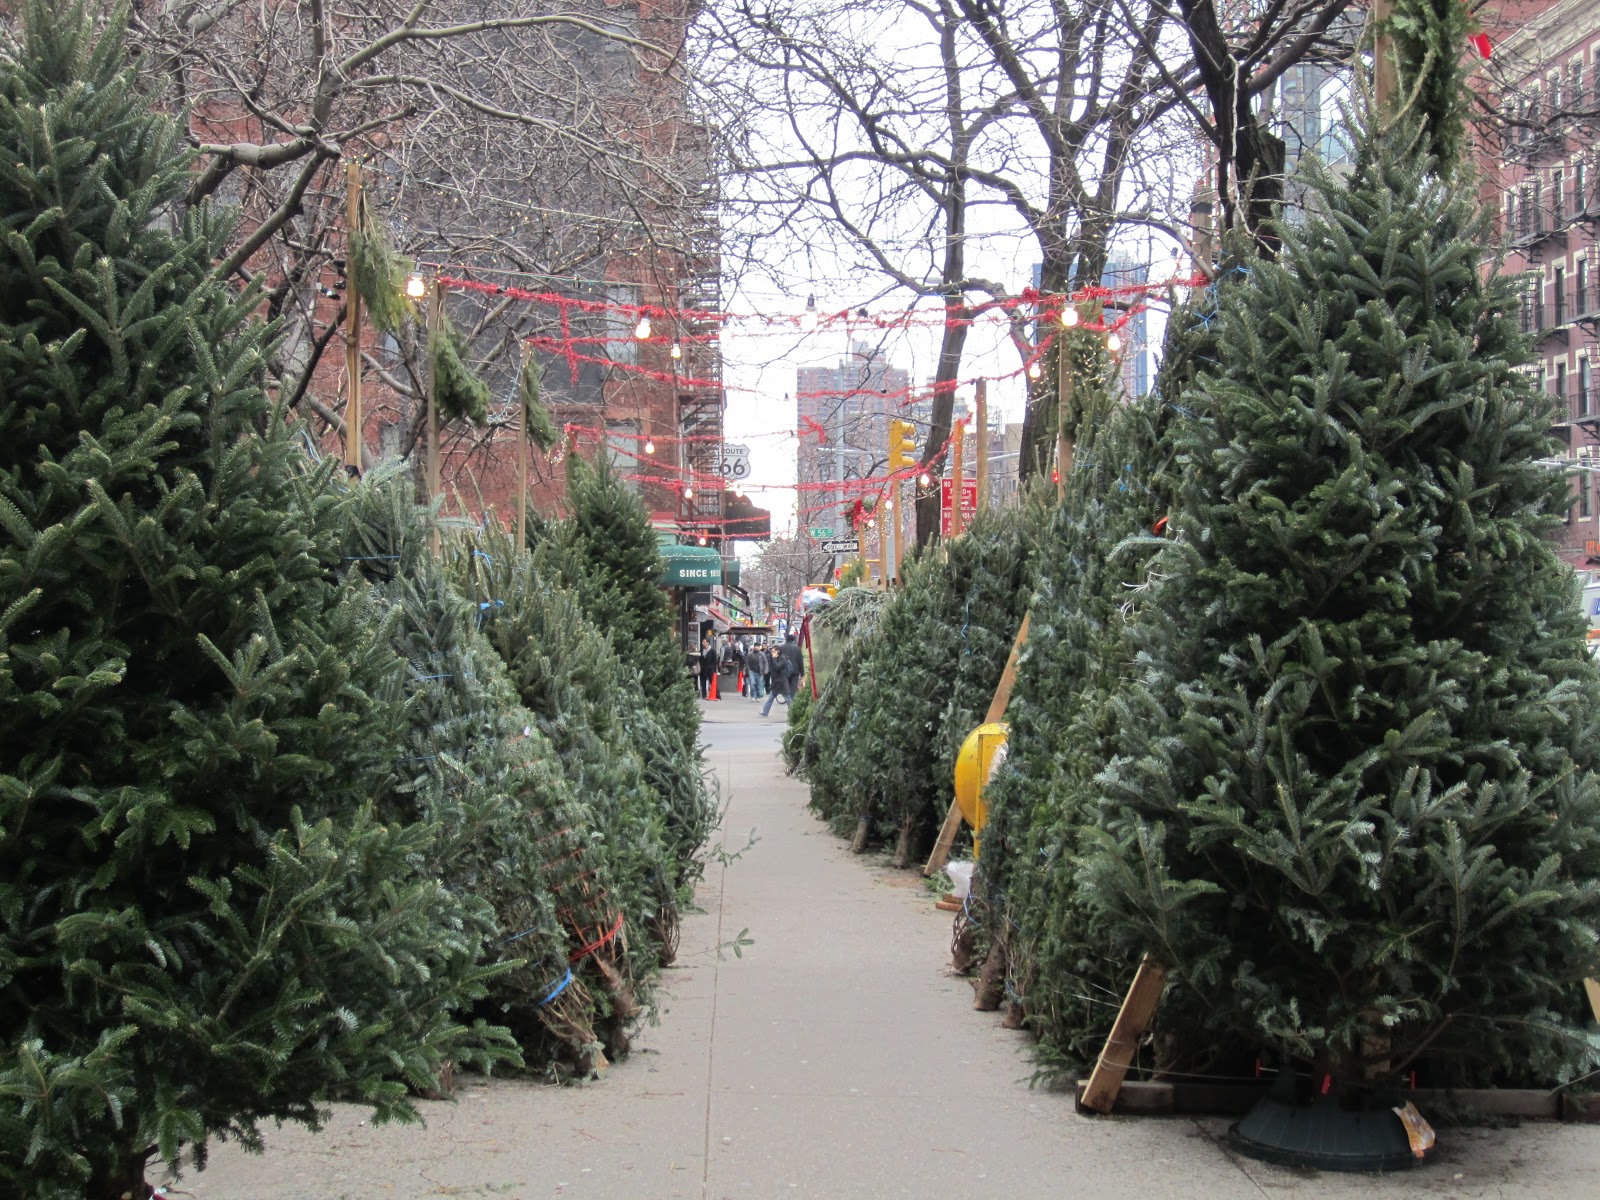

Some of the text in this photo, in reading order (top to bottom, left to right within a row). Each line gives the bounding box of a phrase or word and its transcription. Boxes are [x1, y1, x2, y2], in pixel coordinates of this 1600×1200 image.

[719, 457, 746, 476] 66
[810, 529, 816, 537] W
[679, 569, 708, 578] SINCE
